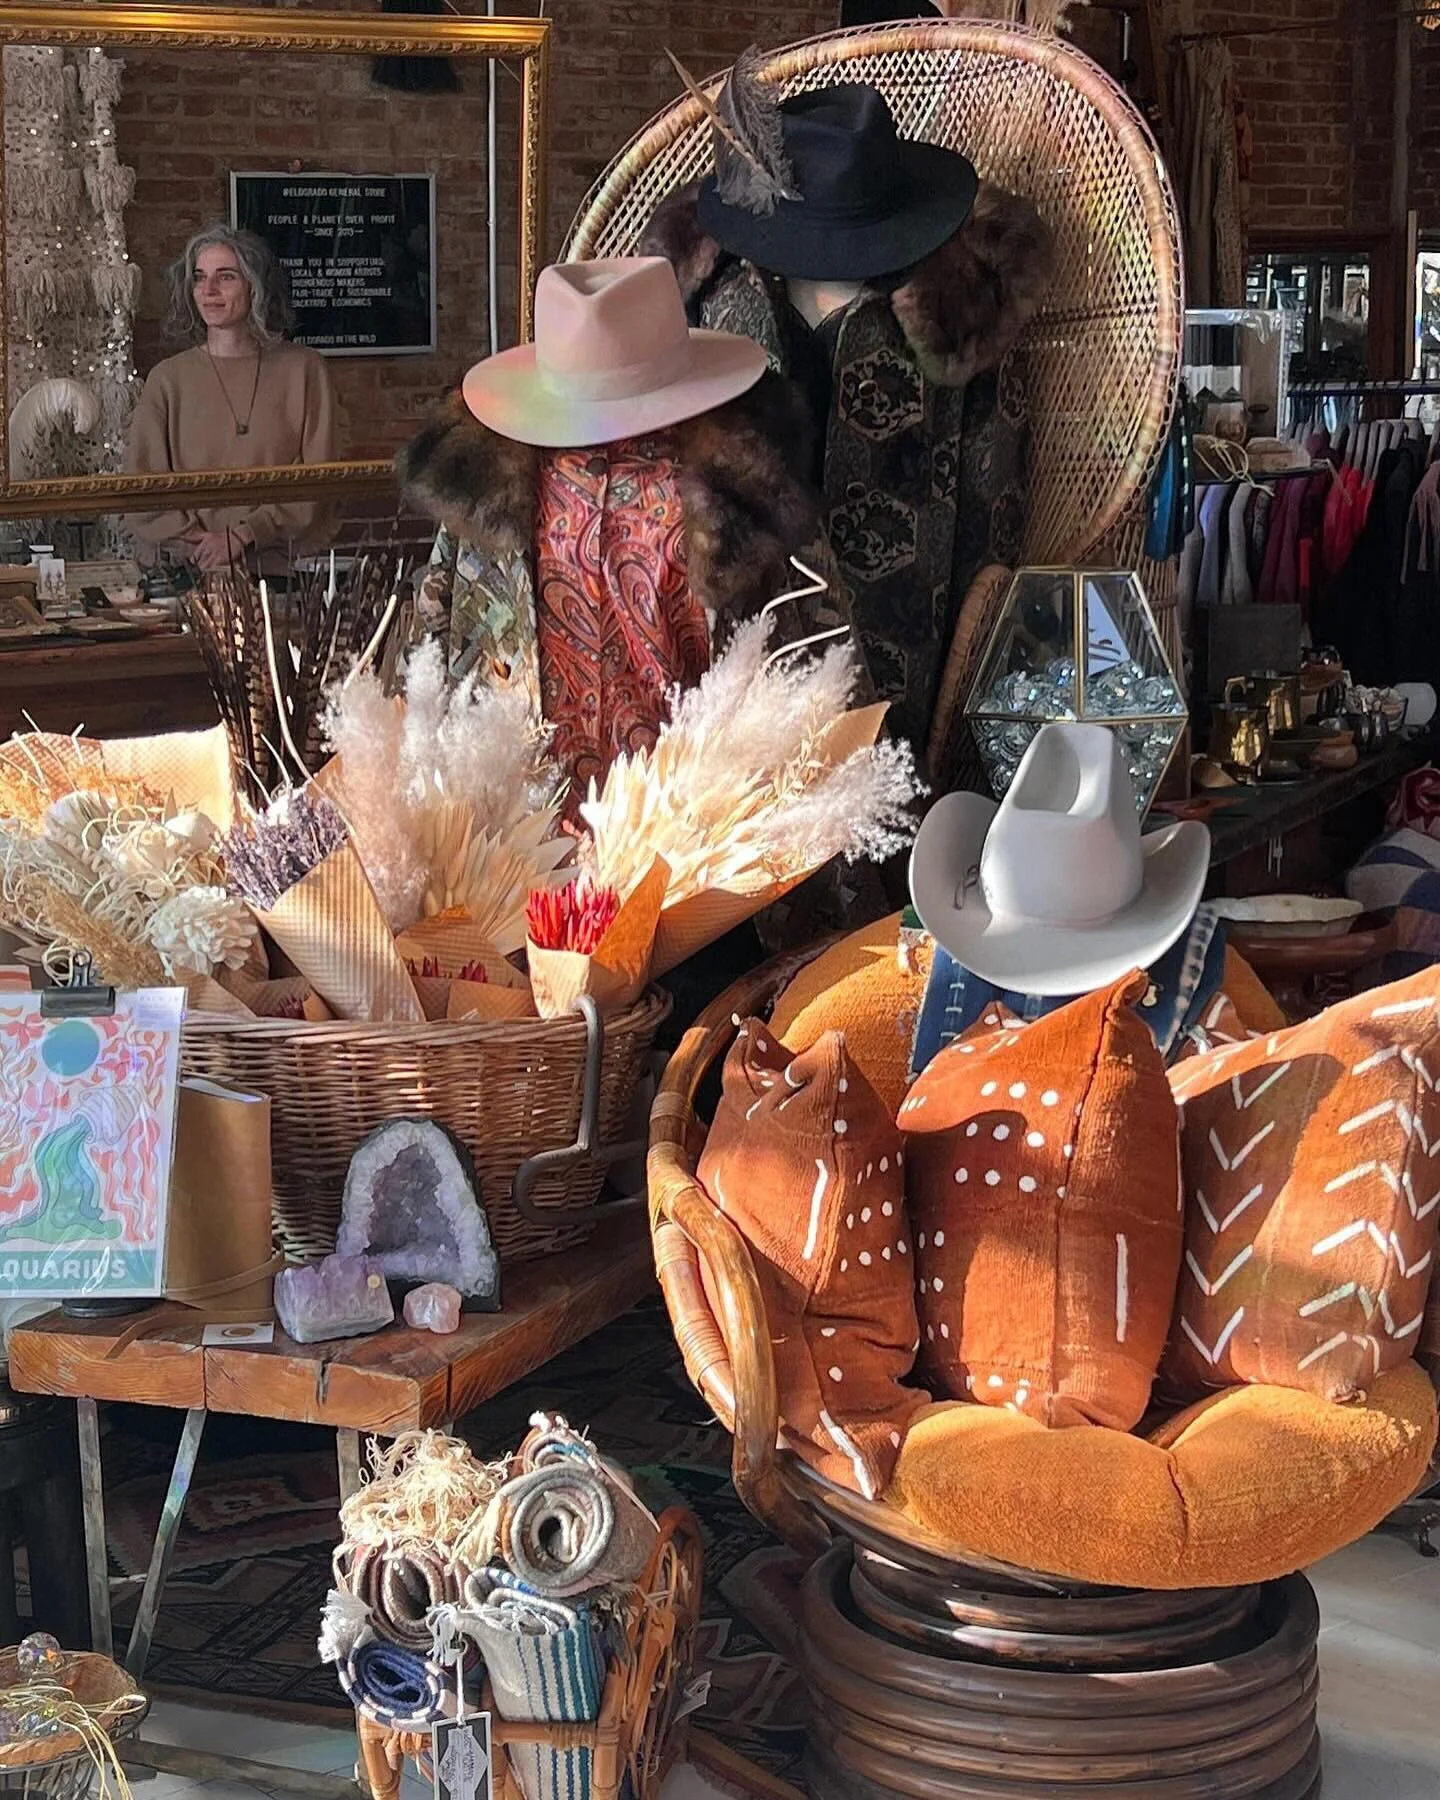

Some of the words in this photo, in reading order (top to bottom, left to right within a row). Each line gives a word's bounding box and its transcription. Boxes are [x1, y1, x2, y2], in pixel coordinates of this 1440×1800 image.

[328, 188, 361, 197] GENERAL
[365, 188, 386, 197] STORE
[268, 215, 298, 224] PEOPLE
[312, 215, 341, 224] PLANET
[345, 215, 364, 224] OVER
[371, 215, 395, 224] PROFIT
[280, 258, 304, 267] THANK
[308, 258, 322, 267] YOU
[291, 268, 313, 277] LOCAL
[354, 267, 382, 277] ARTISTS
[336, 278, 366, 287] MAKERS
[347, 287, 392, 297] SUSTAINABLE
[331, 298, 372, 307] ECONOMICS
